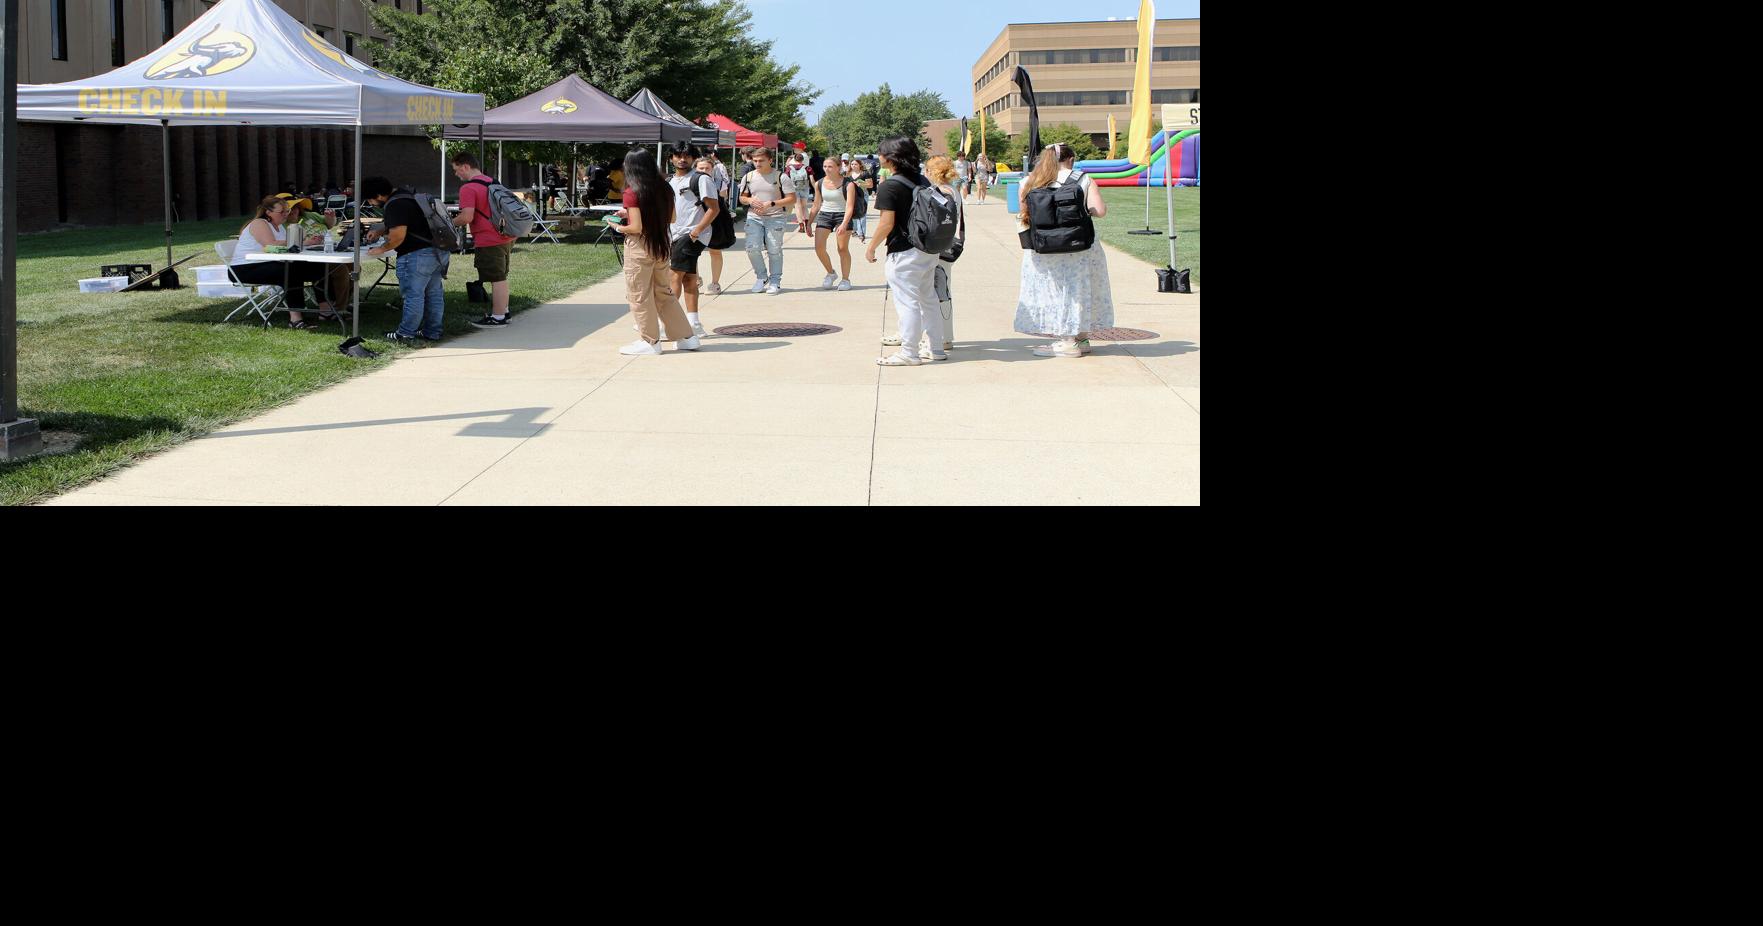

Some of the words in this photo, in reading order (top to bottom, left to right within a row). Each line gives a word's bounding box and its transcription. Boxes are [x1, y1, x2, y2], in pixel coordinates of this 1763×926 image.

[79, 88, 184, 116] CHECK
[192, 89, 227, 117] IN
[407, 95, 441, 121] CHECK
[443, 97, 454, 121] IN
